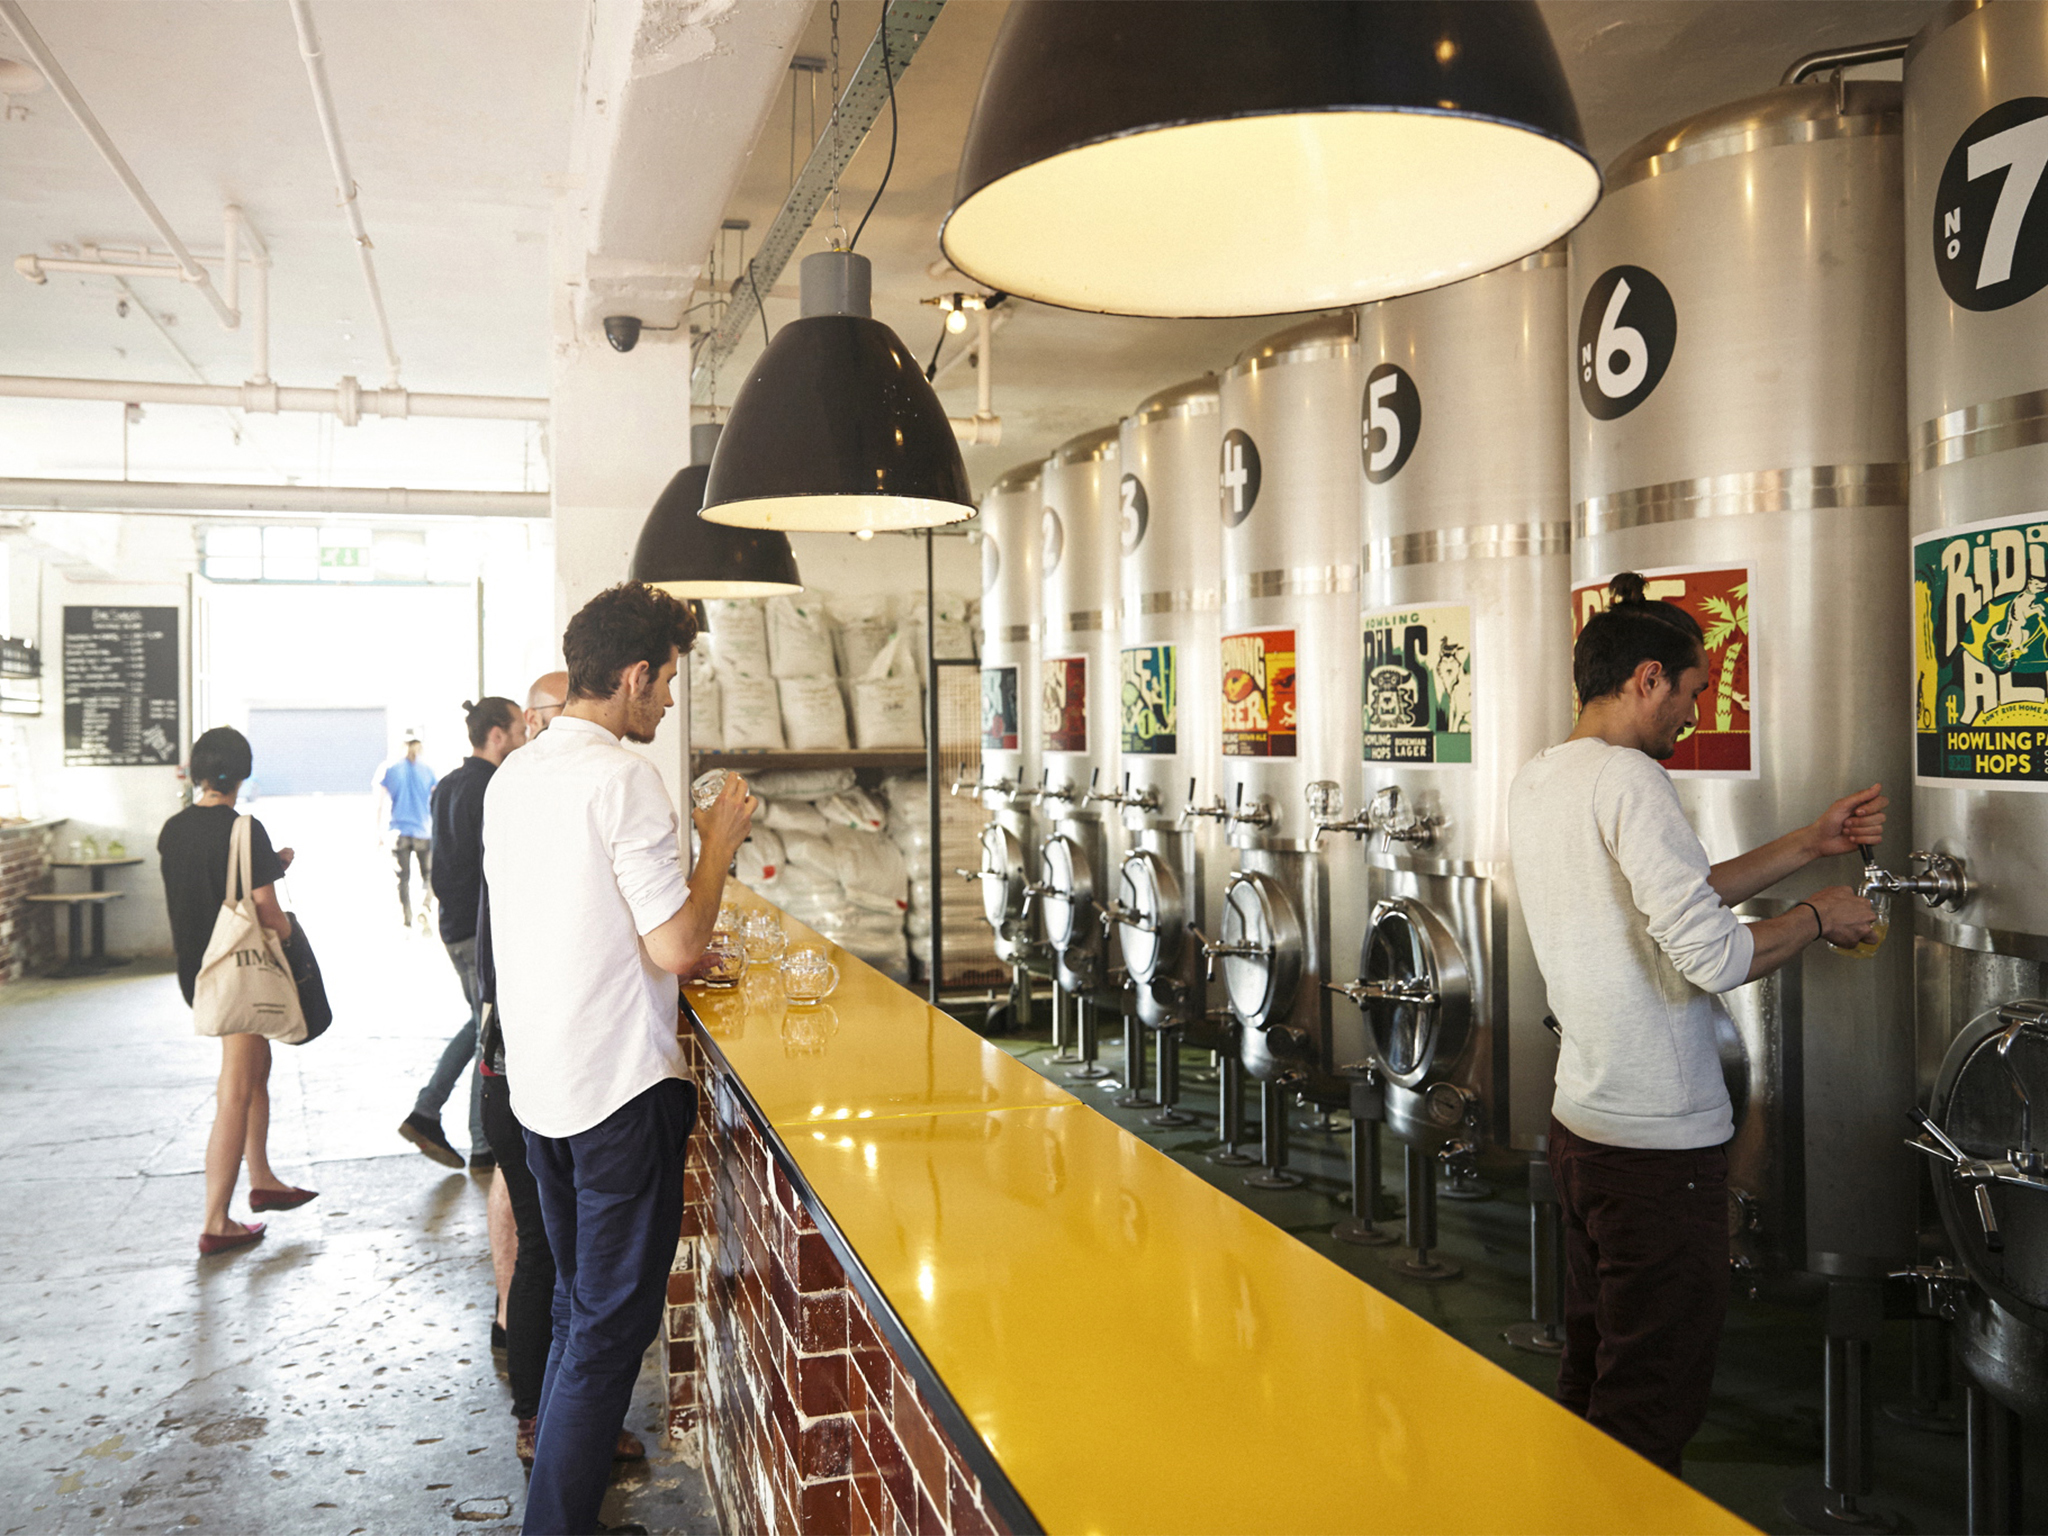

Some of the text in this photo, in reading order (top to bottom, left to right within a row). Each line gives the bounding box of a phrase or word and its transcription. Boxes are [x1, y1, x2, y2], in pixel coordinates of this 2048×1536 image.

[1967, 114, 2048, 290] 7
[1596, 277, 1649, 399] 6
[1369, 373, 1401, 472] 5
[1223, 439, 1248, 513] 4
[1121, 479, 1140, 549] 3
[1960, 649, 2048, 725] AL
[1395, 745, 1427, 757] LAGER
[1948, 731, 2032, 751] HOWLING
[1975, 753, 2032, 774] HOPS
